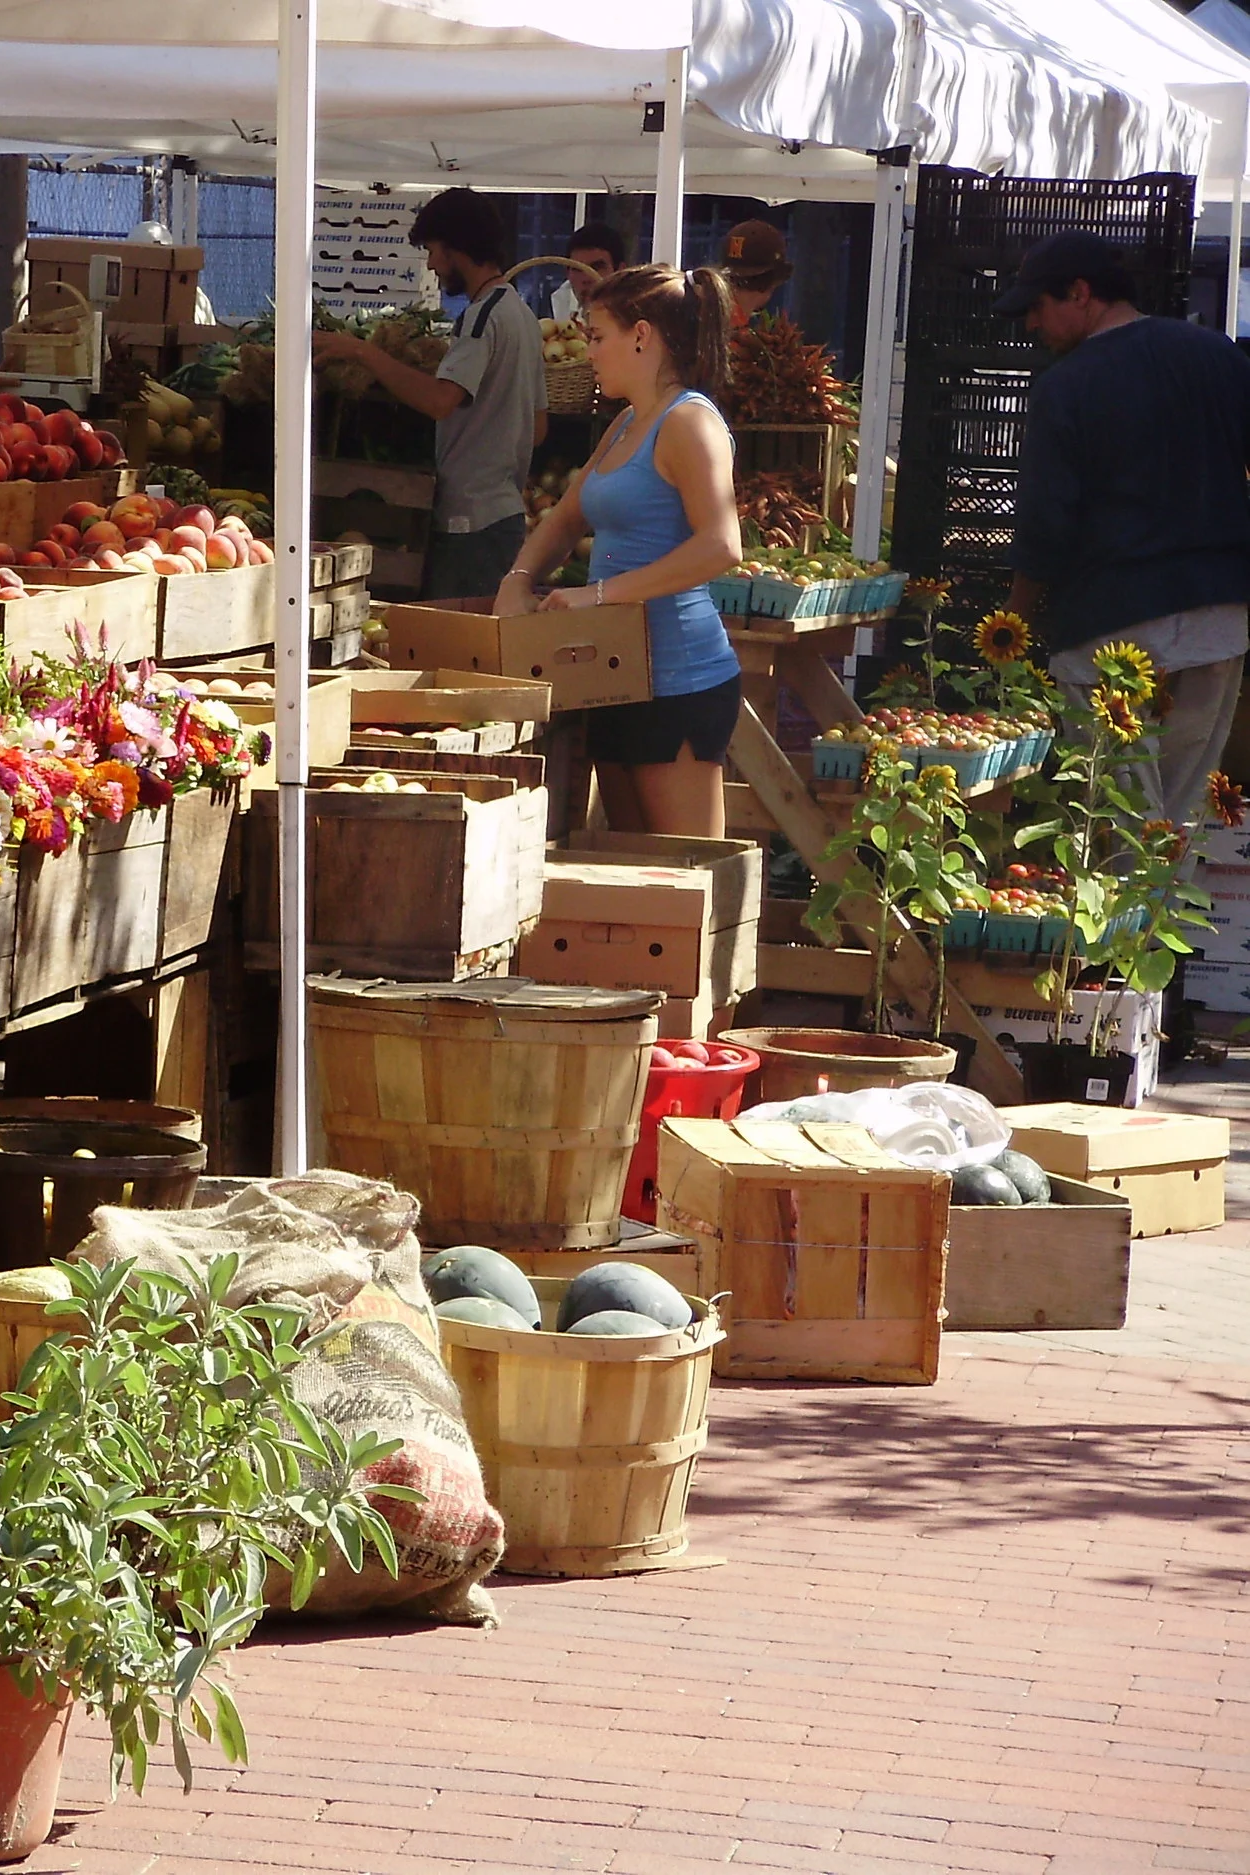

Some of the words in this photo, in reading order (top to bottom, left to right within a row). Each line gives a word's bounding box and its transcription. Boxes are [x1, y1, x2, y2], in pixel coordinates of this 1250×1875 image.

[360, 202, 406, 211] BLUEBERRIES
[358, 235, 405, 244] BLUEBERRIES
[350, 266, 396, 276] BLUEBERRIES
[1004, 1007, 1084, 1025] BLUEBERIES
